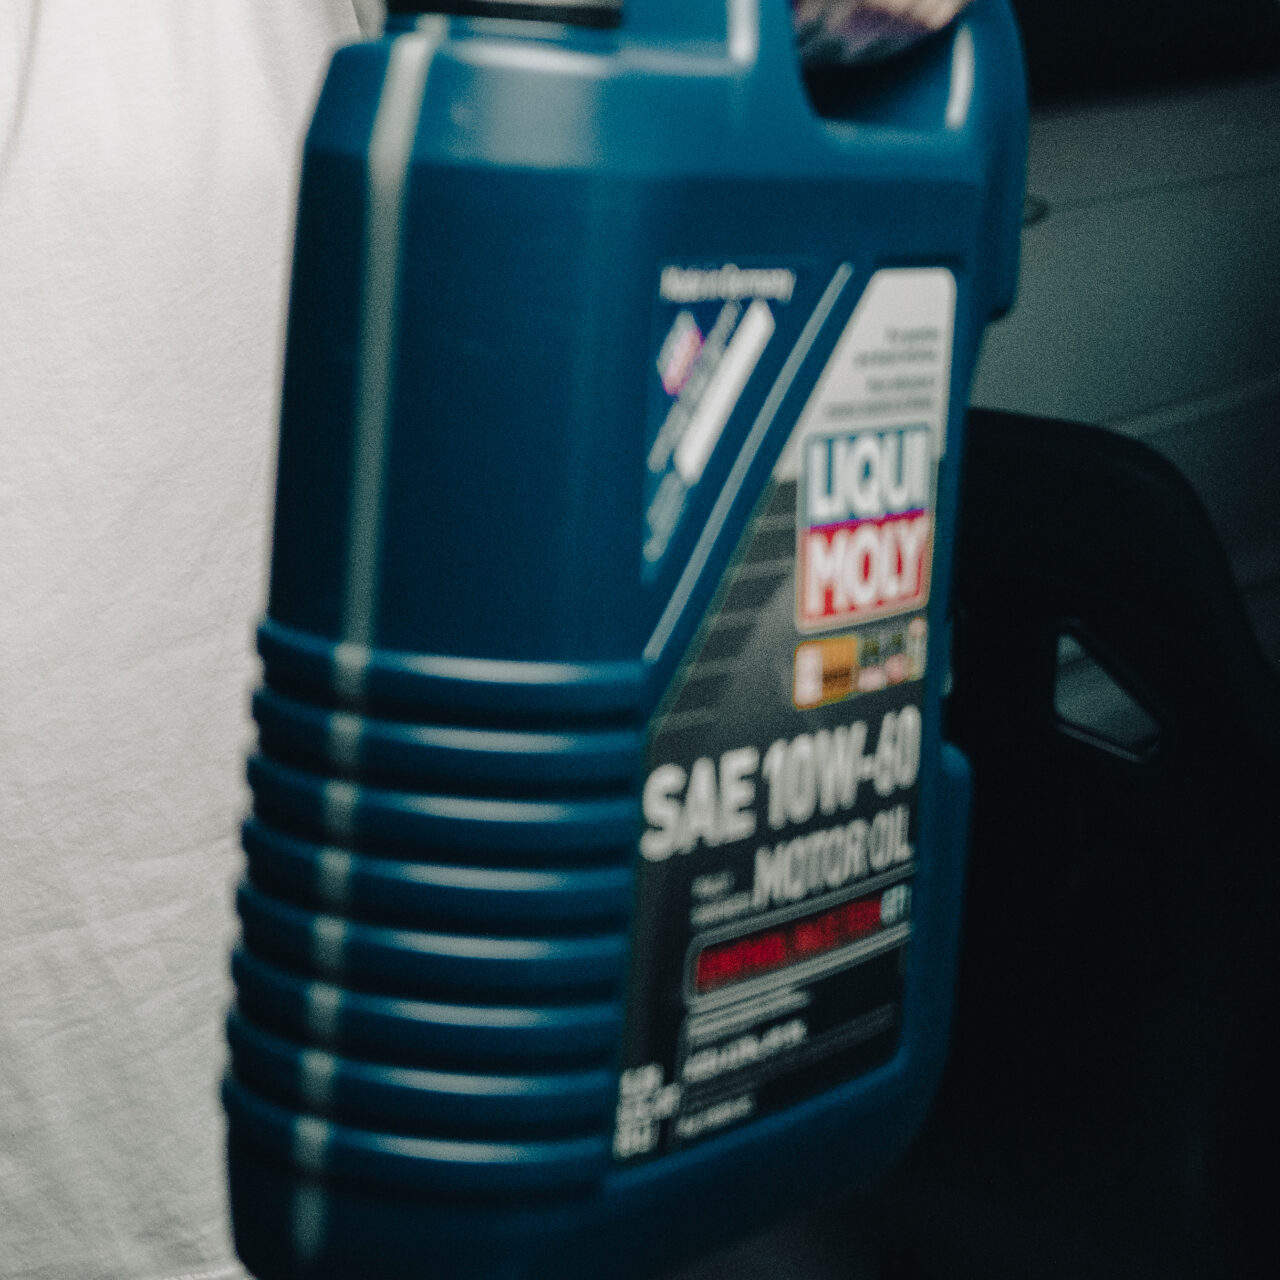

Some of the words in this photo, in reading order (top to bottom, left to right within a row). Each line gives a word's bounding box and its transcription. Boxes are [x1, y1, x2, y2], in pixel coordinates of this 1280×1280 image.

[810, 431, 929, 519] LIQUI
[806, 521, 926, 613] MOLY
[639, 746, 760, 862] SAE
[752, 820, 869, 907] MOTOR
[870, 804, 914, 871] OIL
